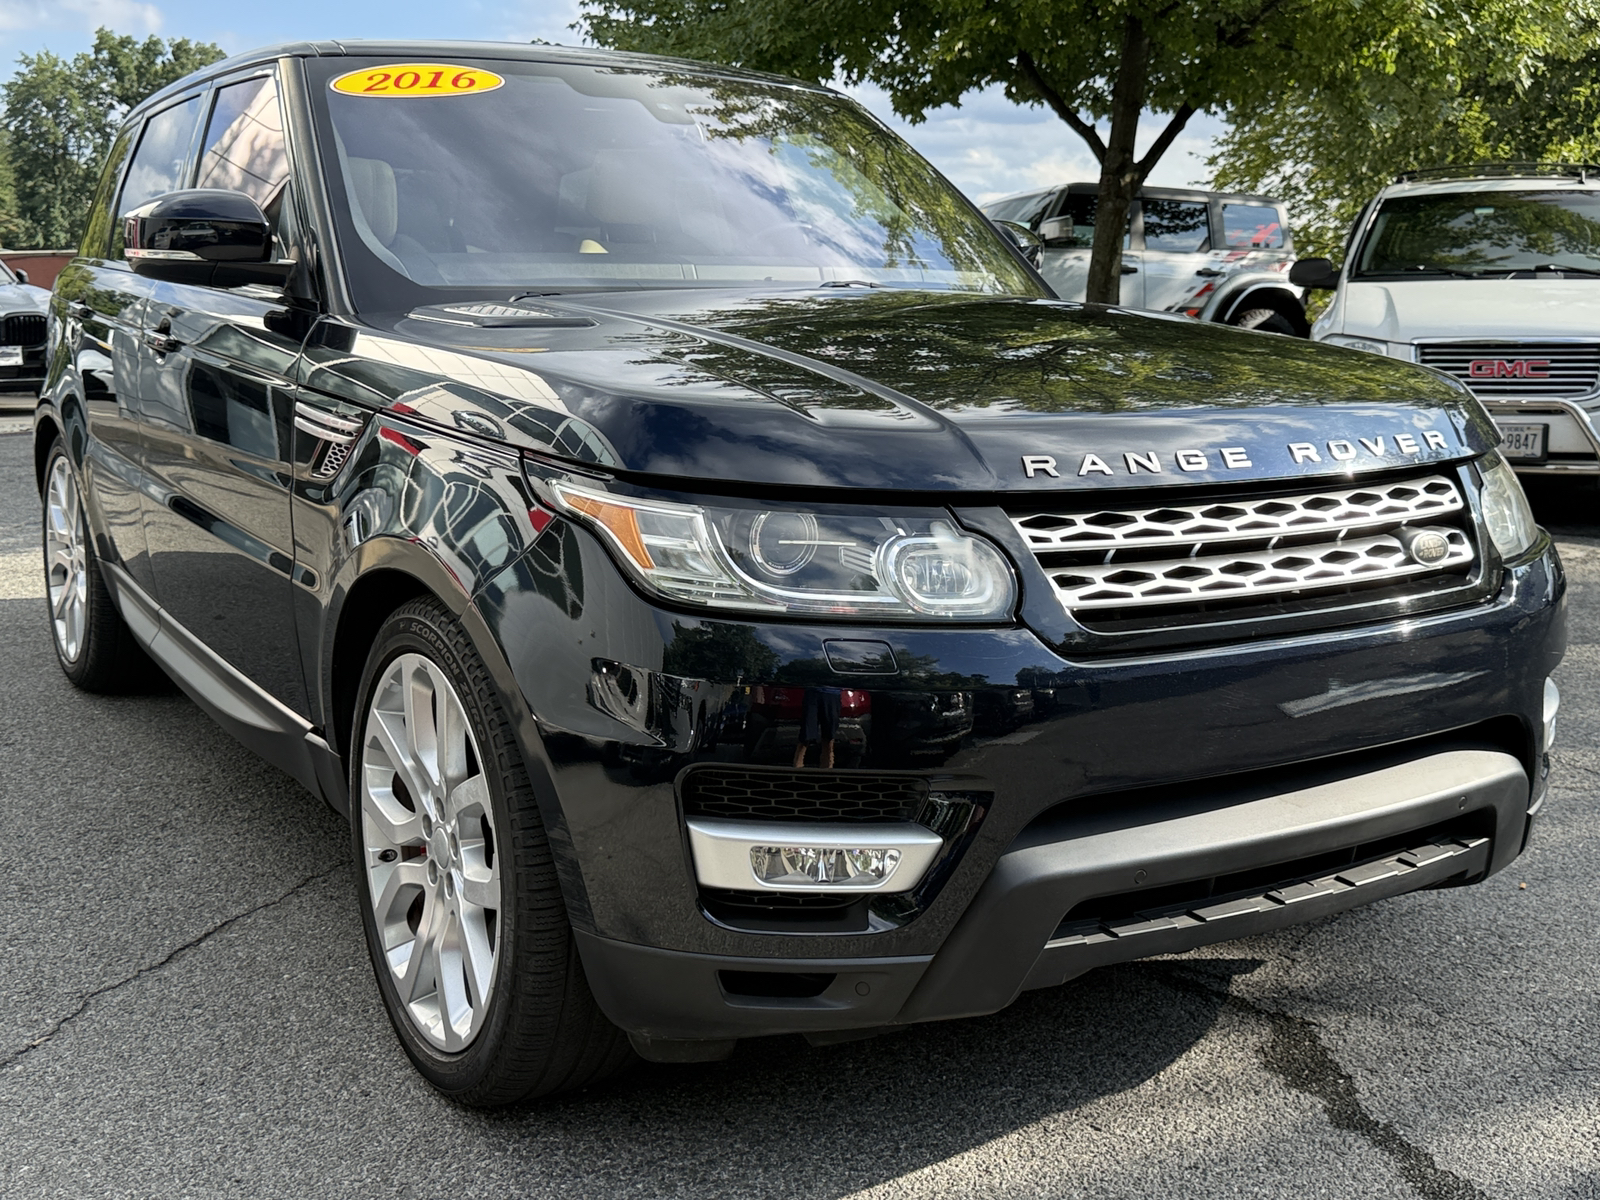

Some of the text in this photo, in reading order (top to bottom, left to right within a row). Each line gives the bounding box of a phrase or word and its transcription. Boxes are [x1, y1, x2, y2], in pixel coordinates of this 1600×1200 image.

[363, 71, 477, 92] 2016
[1469, 360, 1551, 378] GMC
[1506, 433, 1538, 450] 9847
[1021, 430, 1449, 478] RANGE ROVER
[409, 621, 461, 676] SCORPION
[459, 681, 488, 742] ZERO
